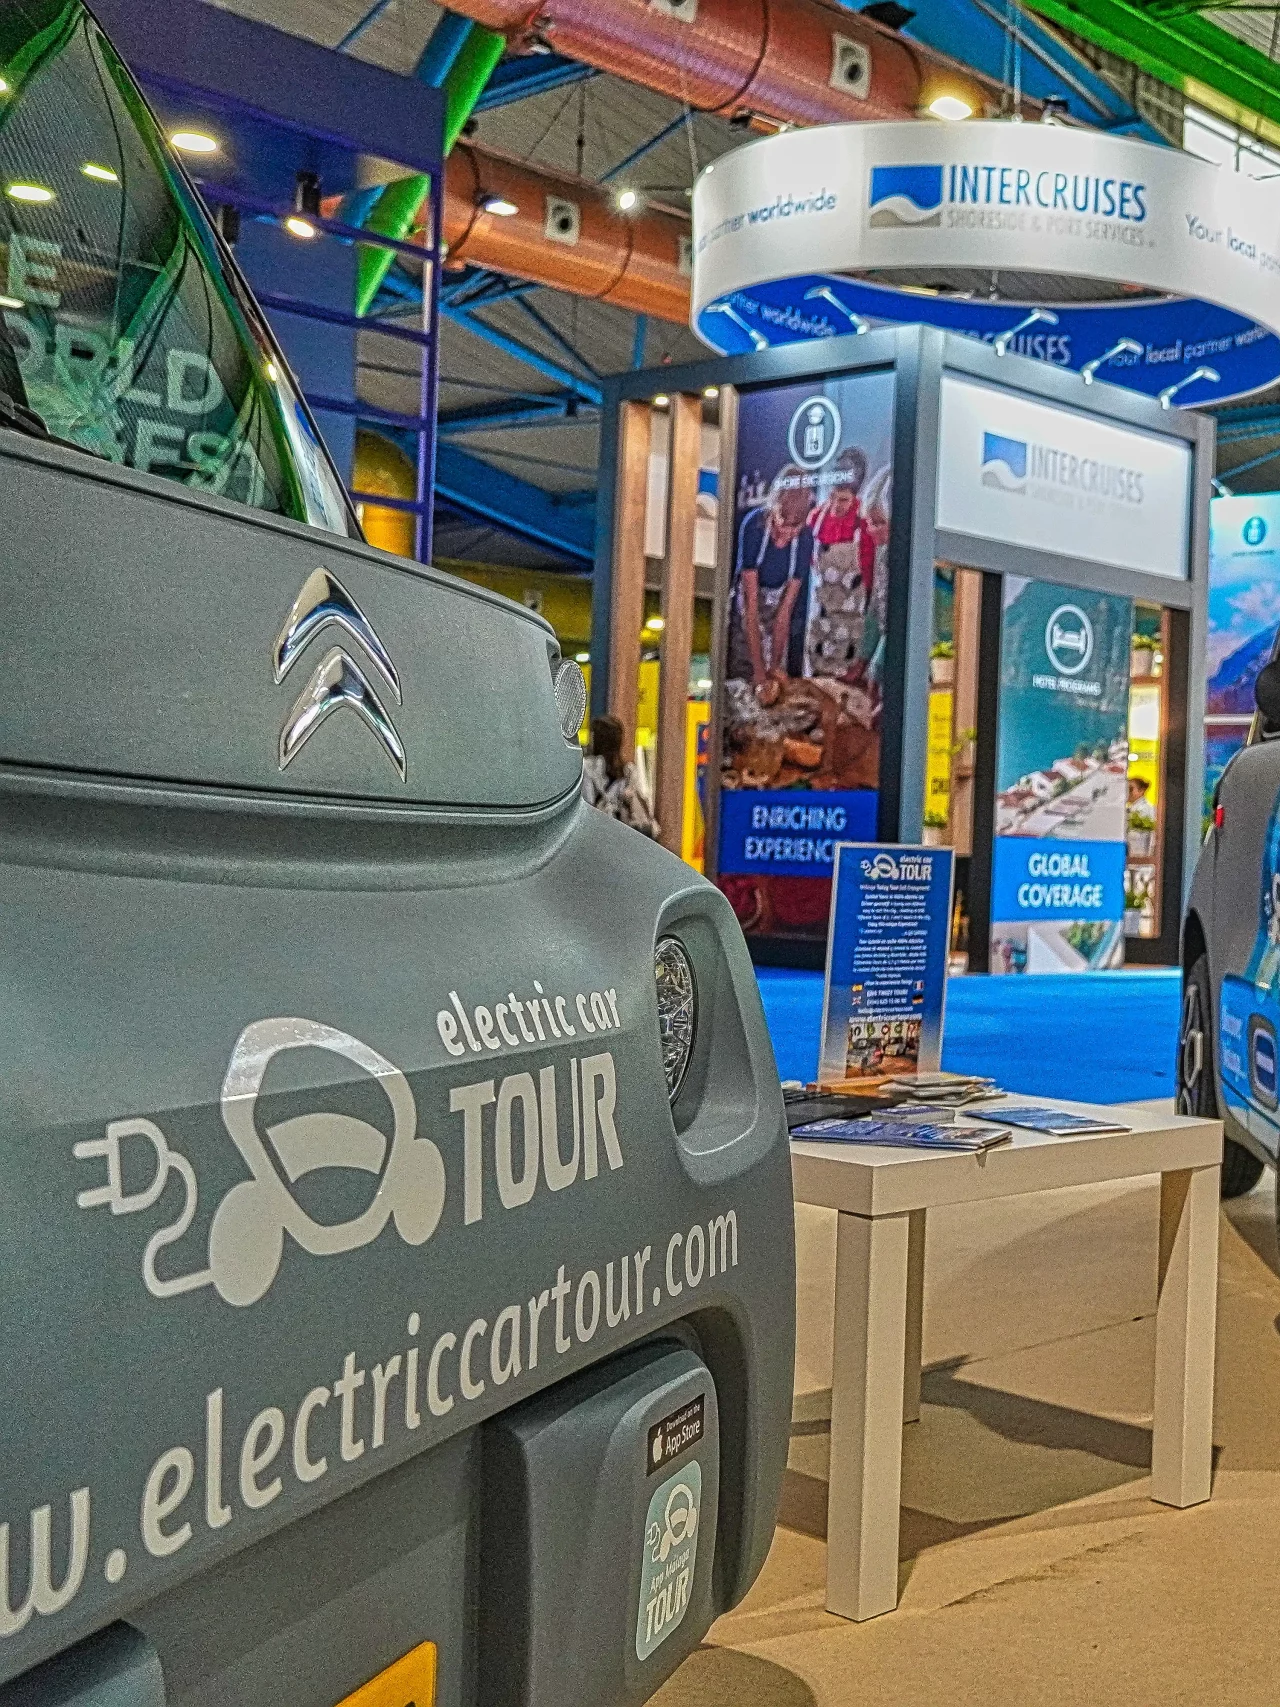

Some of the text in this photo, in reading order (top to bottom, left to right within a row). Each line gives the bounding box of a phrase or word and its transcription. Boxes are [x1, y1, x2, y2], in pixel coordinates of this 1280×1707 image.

[748, 187, 837, 223] worldwide
[950, 165, 1147, 222] INTERCRUISES
[1085, 221, 1146, 247] SERVICES
[1186, 213, 1222, 244] Your
[1227, 226, 1257, 260] local
[1032, 443, 1144, 504] INTERCRUISES
[752, 804, 847, 832] ENRICHING
[744, 835, 834, 863] EXPERIENC
[1028, 852, 1091, 878] GLOBAL
[900, 864, 932, 881] TOUR
[1018, 883, 1104, 908] COVERAGE
[437, 981, 619, 1057] electric car
[449, 1051, 624, 1226] TOUR
[665, 1419, 700, 1456] App Store
[650, 1574, 664, 1595] App
[646, 1567, 690, 1643] TOUR
